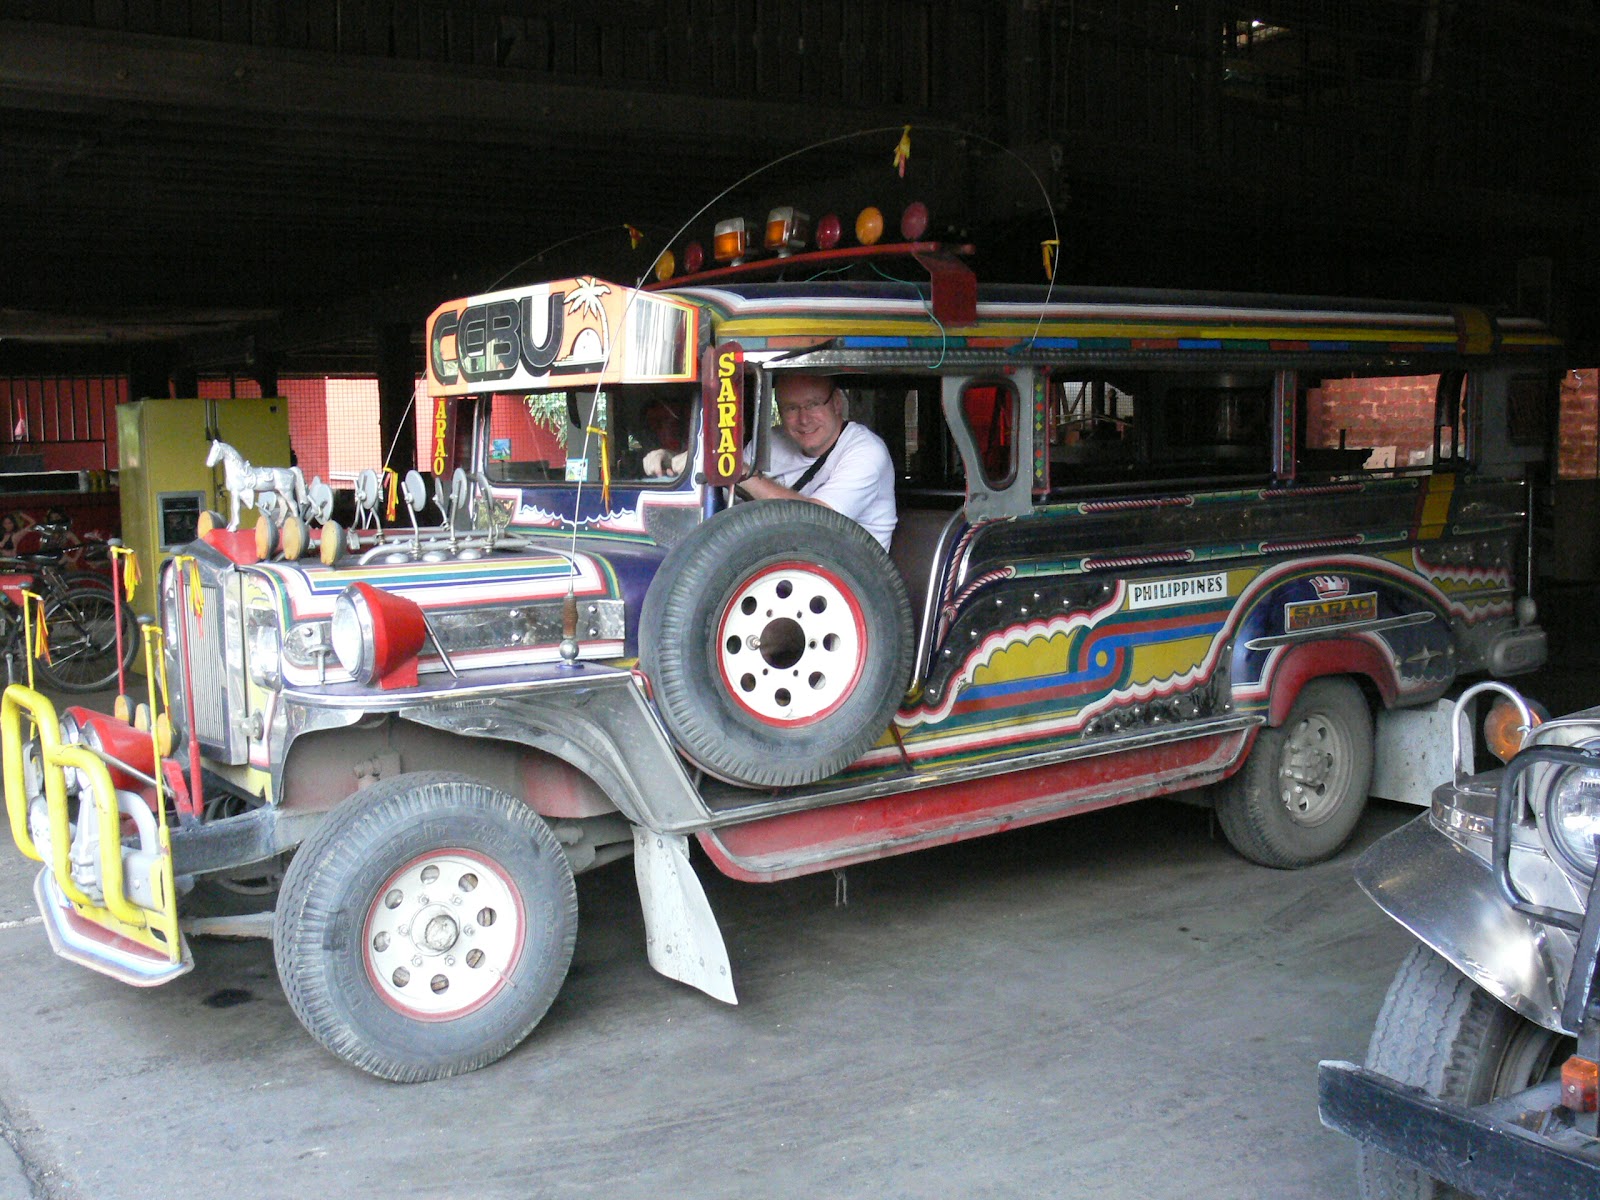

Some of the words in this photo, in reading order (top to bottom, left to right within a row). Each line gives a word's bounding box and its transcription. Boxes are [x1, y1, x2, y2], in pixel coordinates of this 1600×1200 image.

[431, 291, 565, 385] CEBU
[433, 397, 447, 476] ARAO
[717, 351, 737, 478] SARAO
[1134, 576, 1223, 602] PHILIPPINES
[1294, 595, 1373, 618] SARAO
